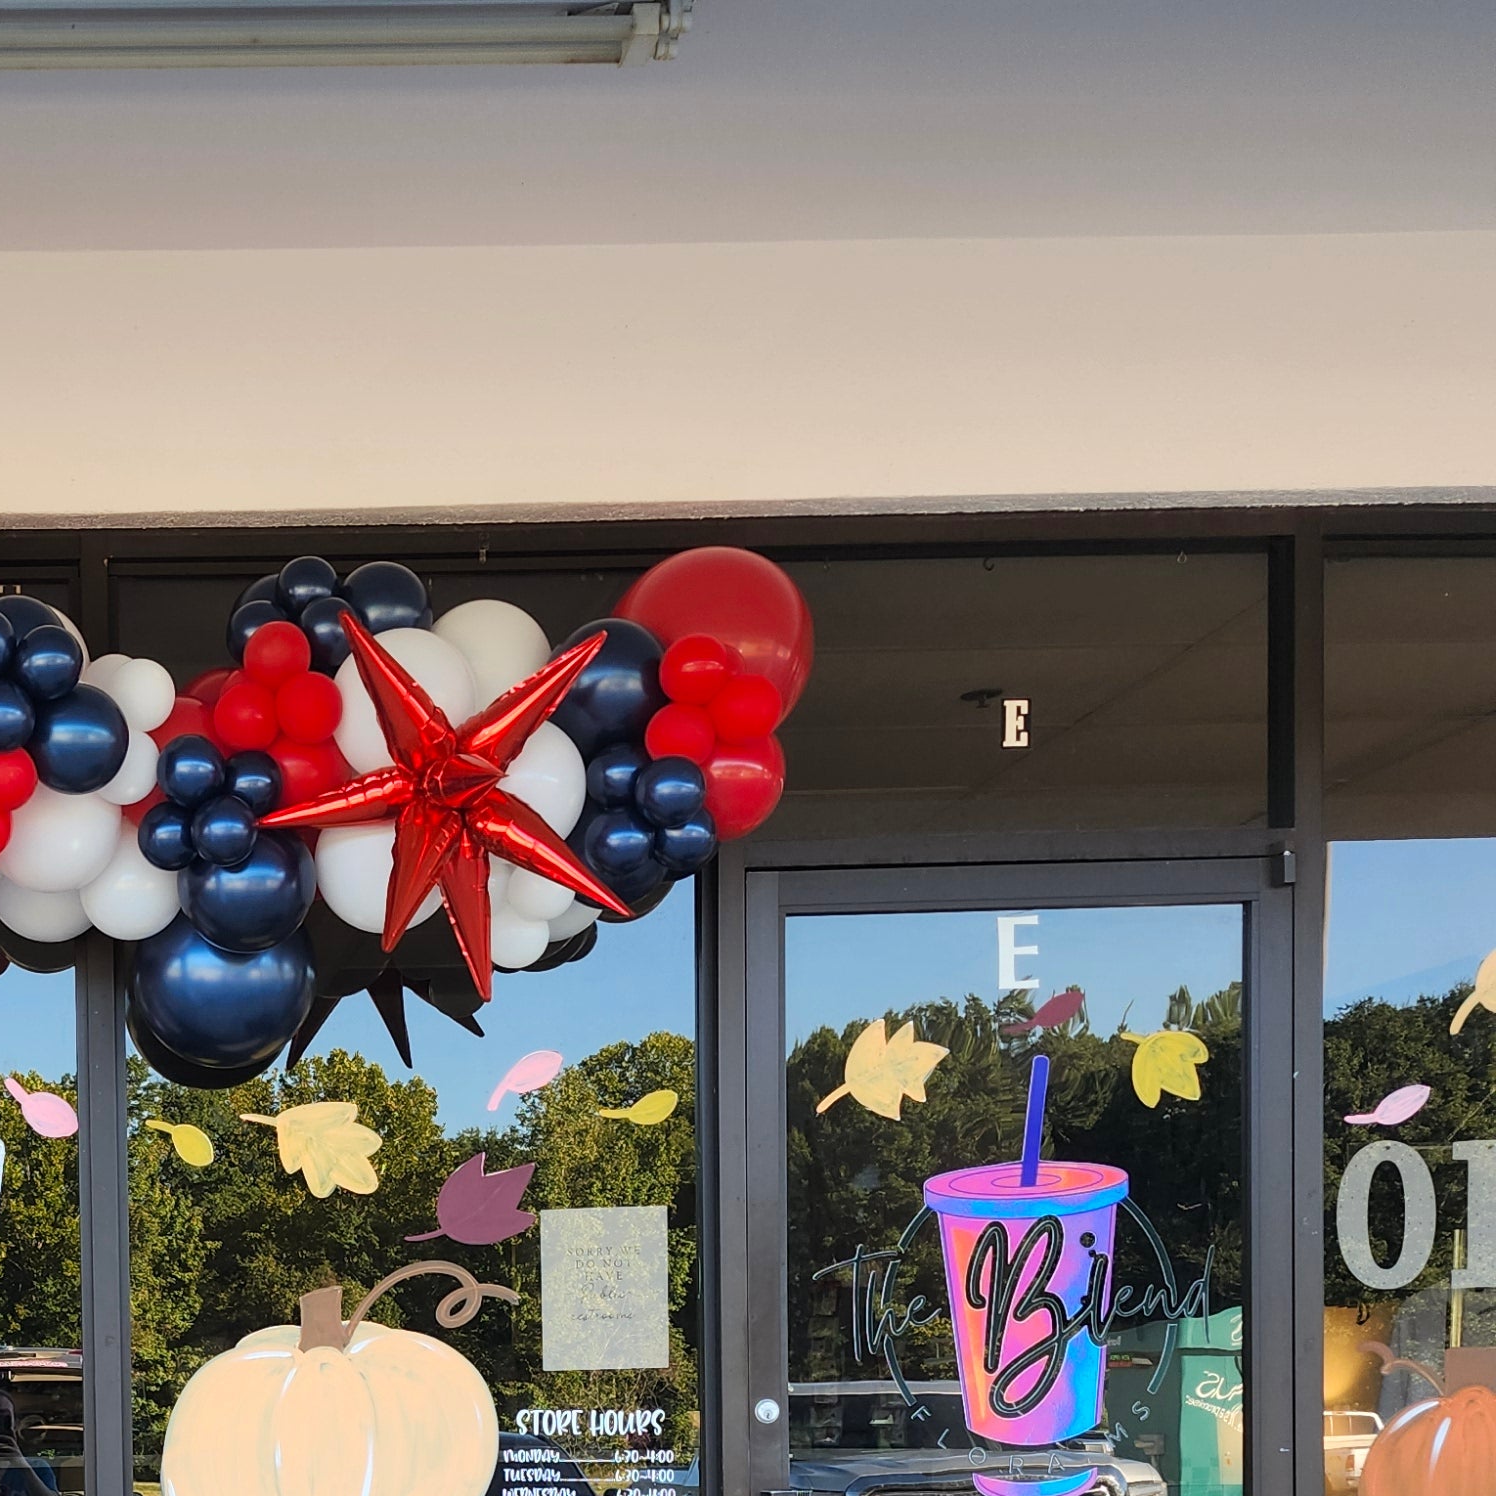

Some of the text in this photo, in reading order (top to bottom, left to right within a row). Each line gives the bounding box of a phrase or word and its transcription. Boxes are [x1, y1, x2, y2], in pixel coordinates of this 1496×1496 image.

[1003, 699, 1029, 748] E
[997, 915, 1040, 989] E
[575, 1259, 595, 1270] DO
[812, 1213, 1215, 1419] The Blend
[516, 1408, 666, 1437] STORE HOURS
[502, 1449, 560, 1464] MONDAY
[503, 1468, 561, 1482] TUESDAY
